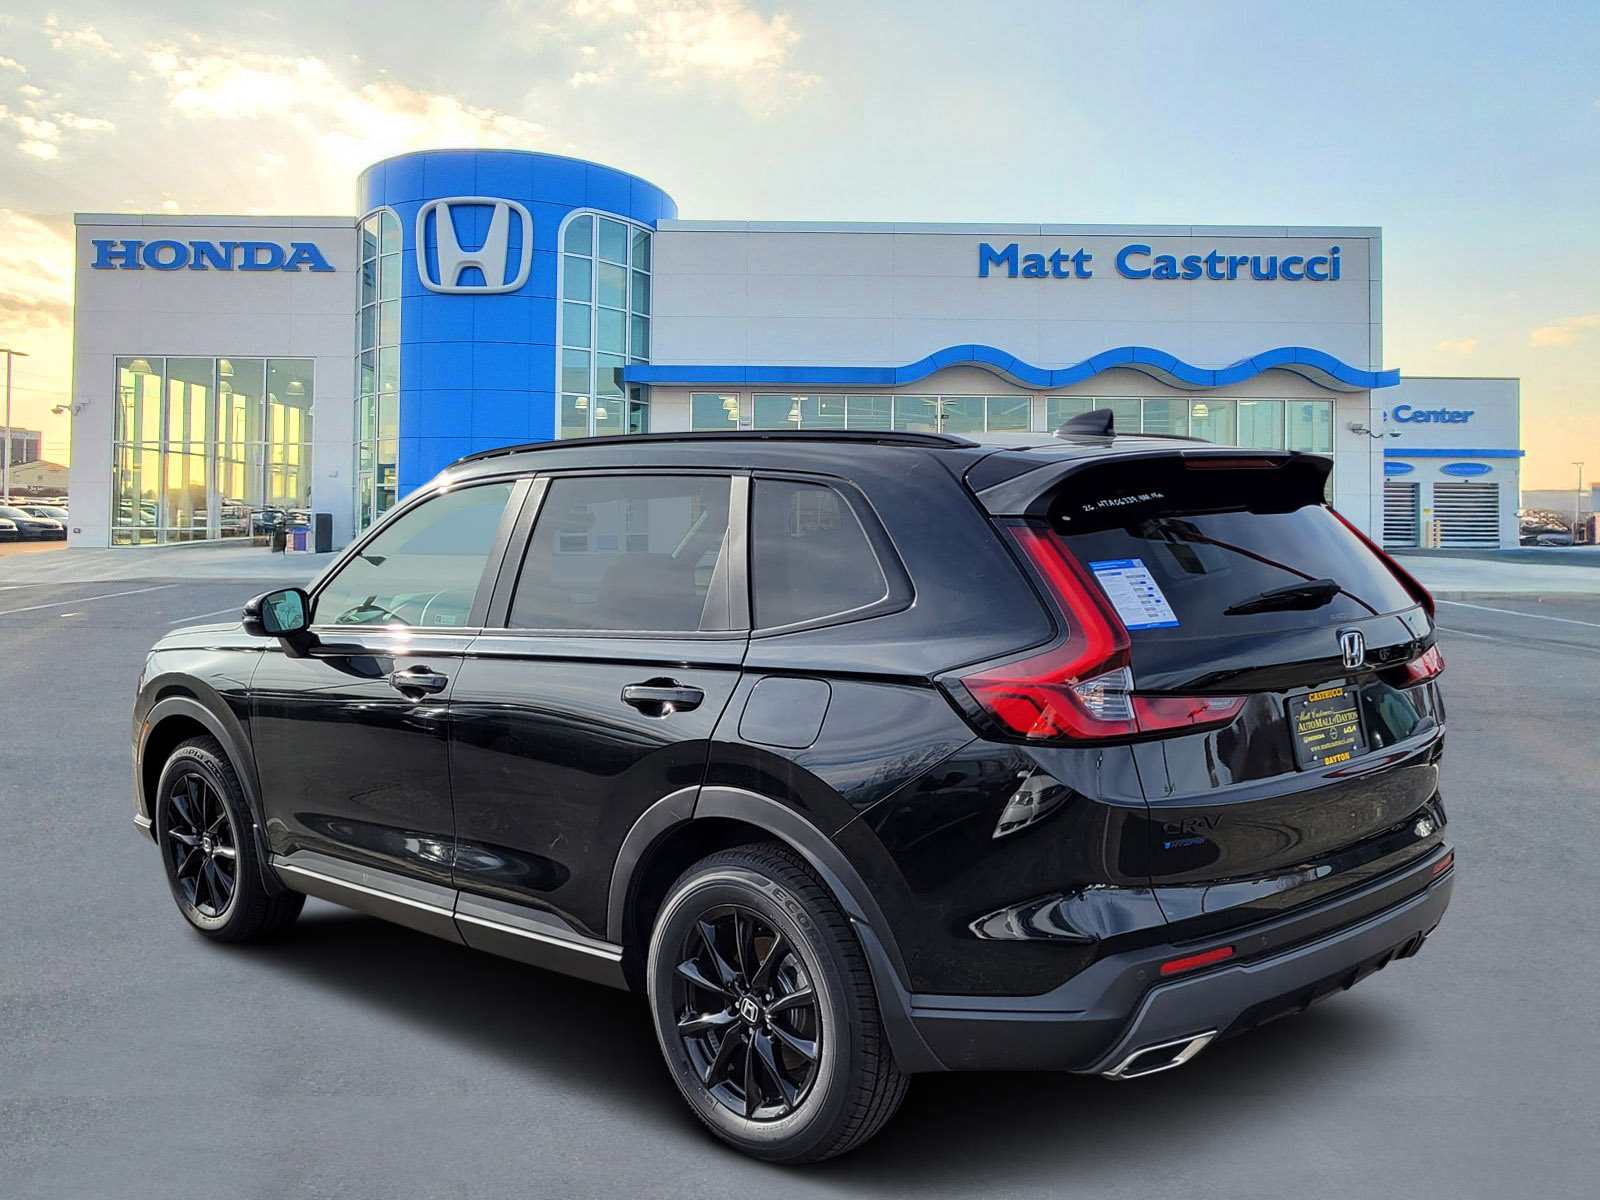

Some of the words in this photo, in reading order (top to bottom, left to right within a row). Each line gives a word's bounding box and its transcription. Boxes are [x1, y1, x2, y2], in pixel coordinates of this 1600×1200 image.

[92, 240, 337, 272] HONDA
[979, 242, 1093, 279] Matt
[1115, 243, 1343, 281] Castrucci
[1391, 404, 1475, 424] Center
[1324, 752, 1350, 765] DAYTON
